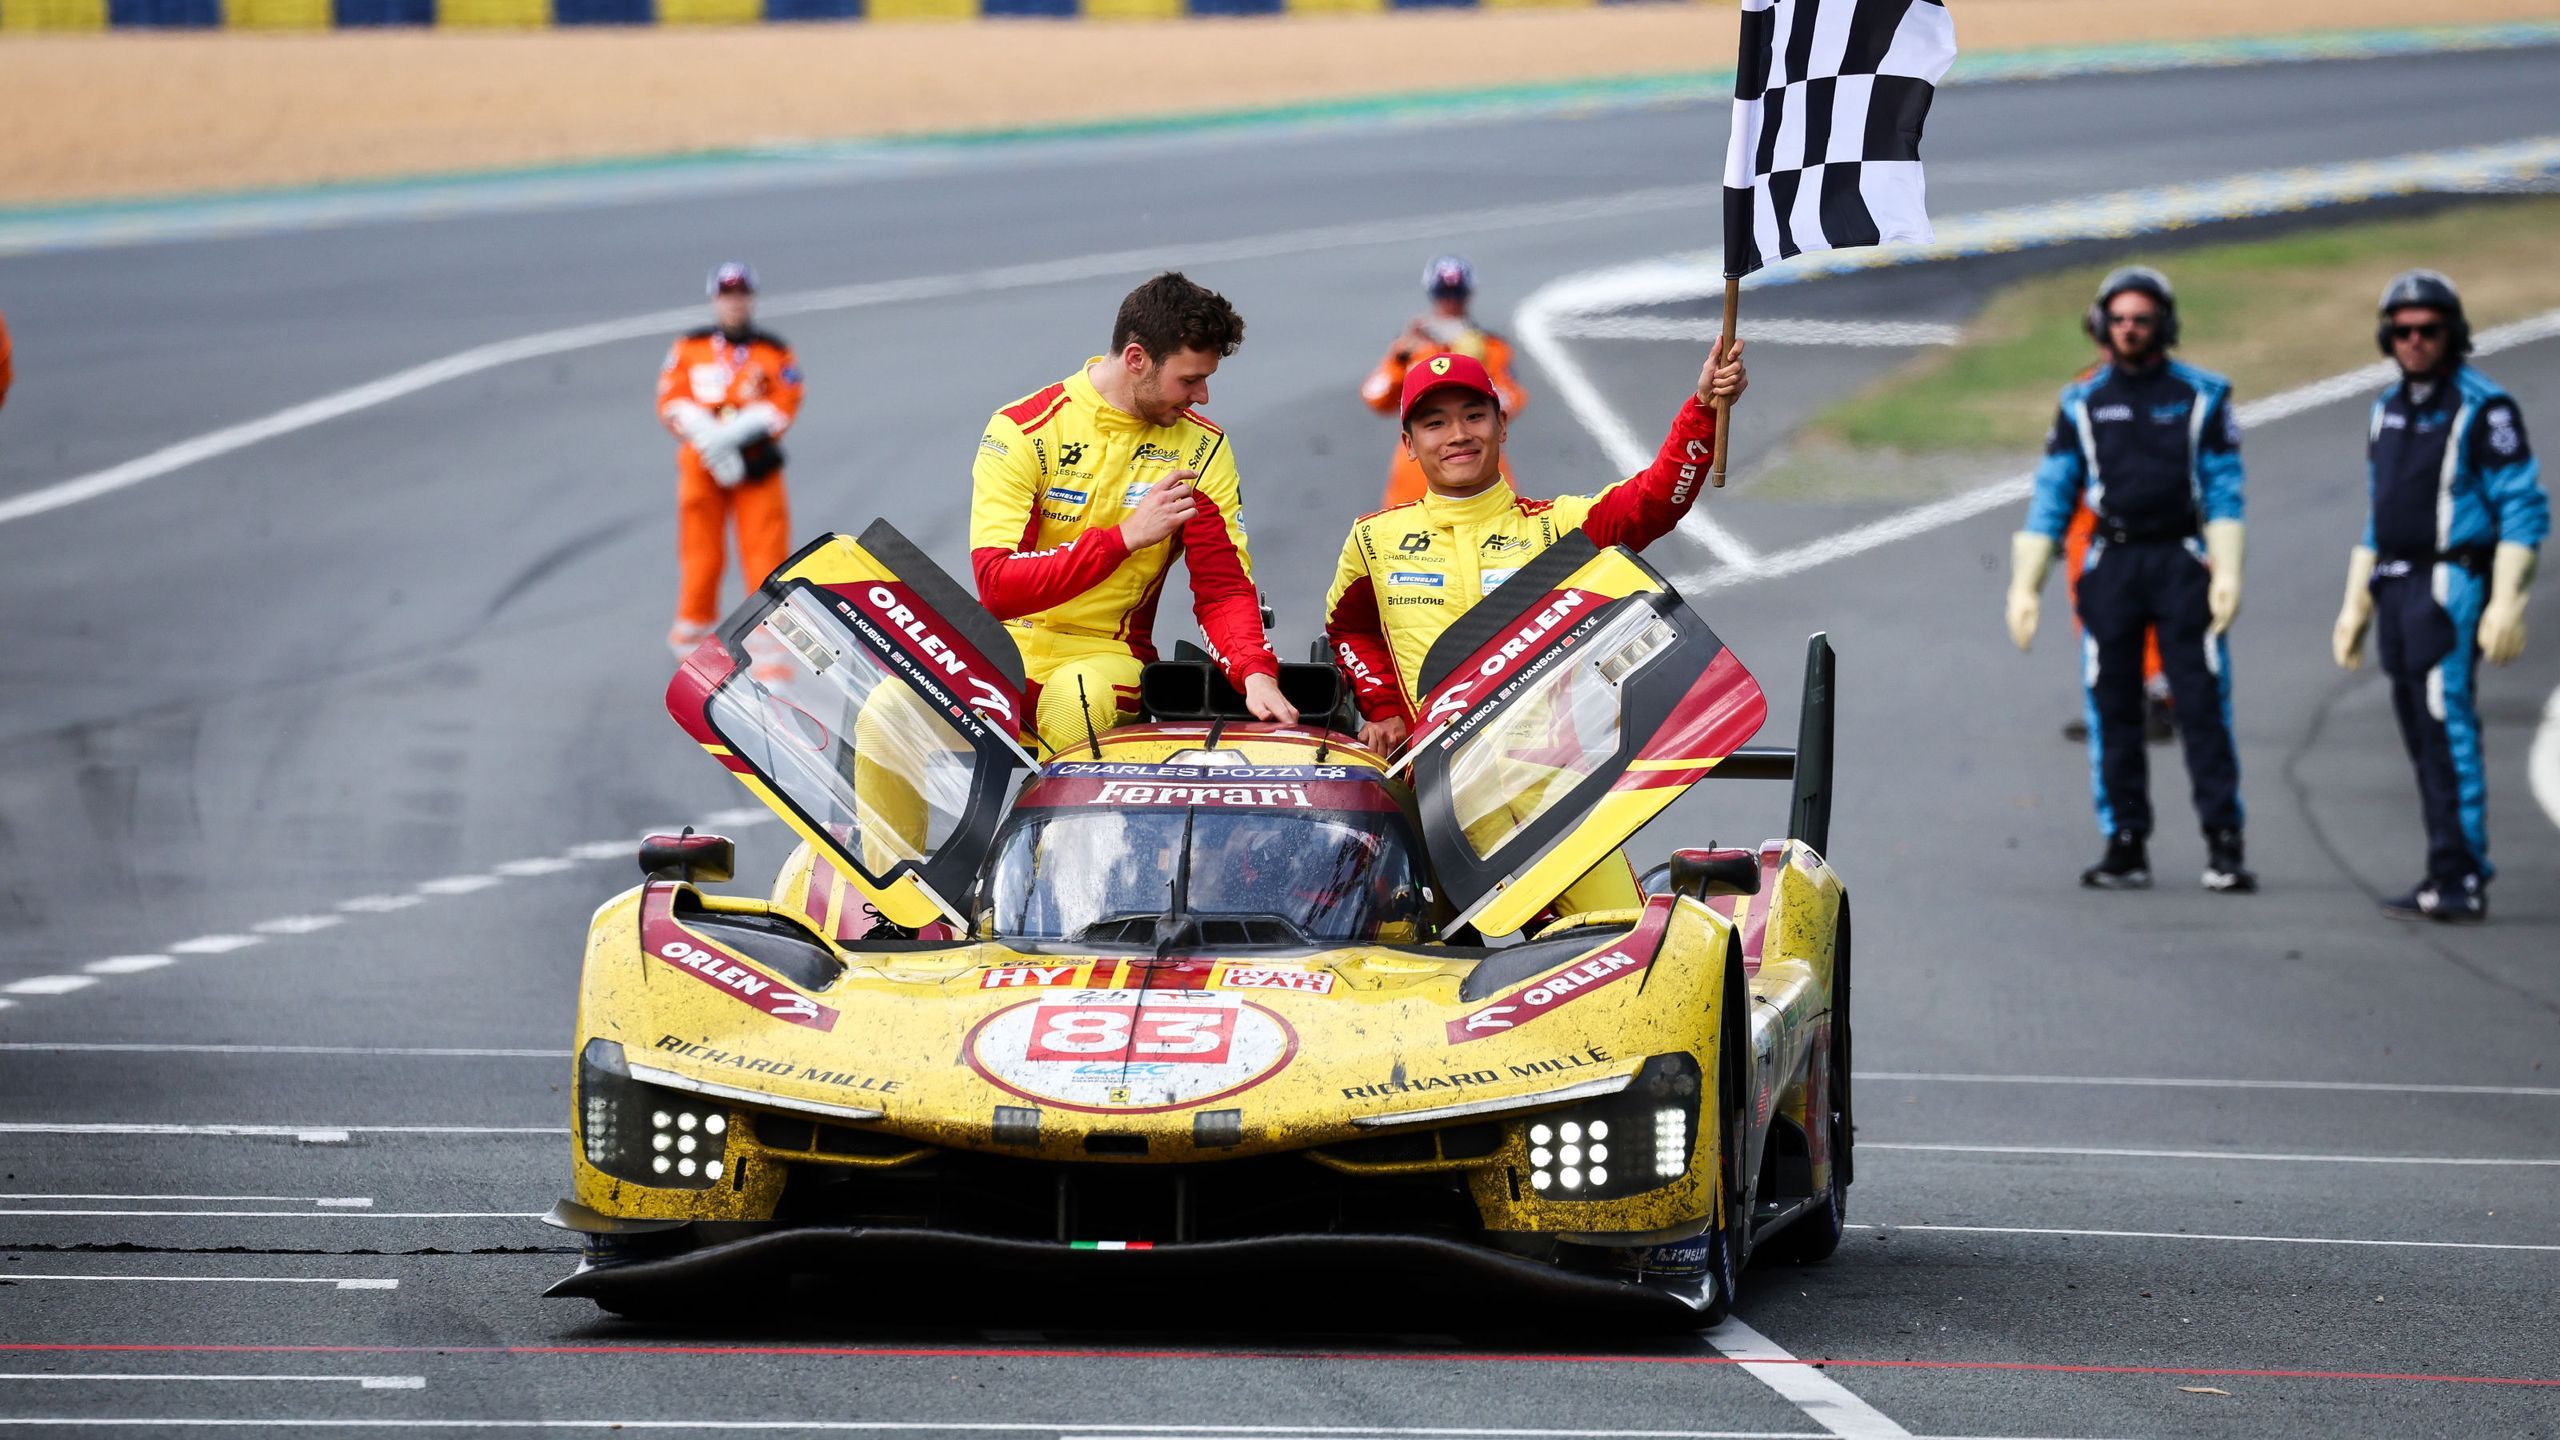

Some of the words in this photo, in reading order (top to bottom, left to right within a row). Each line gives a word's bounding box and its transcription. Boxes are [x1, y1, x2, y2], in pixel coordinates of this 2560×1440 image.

[1188, 433, 1211, 470] Sabelt
[1361, 524, 1377, 561] Sabelt
[1399, 576, 1439, 584] MICHELIN
[1387, 594, 1445, 606] Britestone
[868, 586, 968, 676] ORLEN
[1480, 590, 1584, 676] ORLEN
[1057, 763, 1199, 778] CHARLES
[1207, 767, 1304, 778] POZZI
[1087, 780, 1313, 808] Ferrari
[660, 942, 769, 996] ORLEN
[984, 967, 1073, 988] HY
[1229, 975, 1324, 991] CAR
[1231, 969, 1326, 981] HYPER
[1523, 951, 1635, 1006] ORLEN
[1040, 1011, 1223, 1054] 83
[655, 1034, 793, 1076] RICHARD
[800, 1067, 904, 1095] MILLE
[1341, 1070, 1499, 1100] RICHARD
[1508, 1046, 1612, 1078] MILLE
